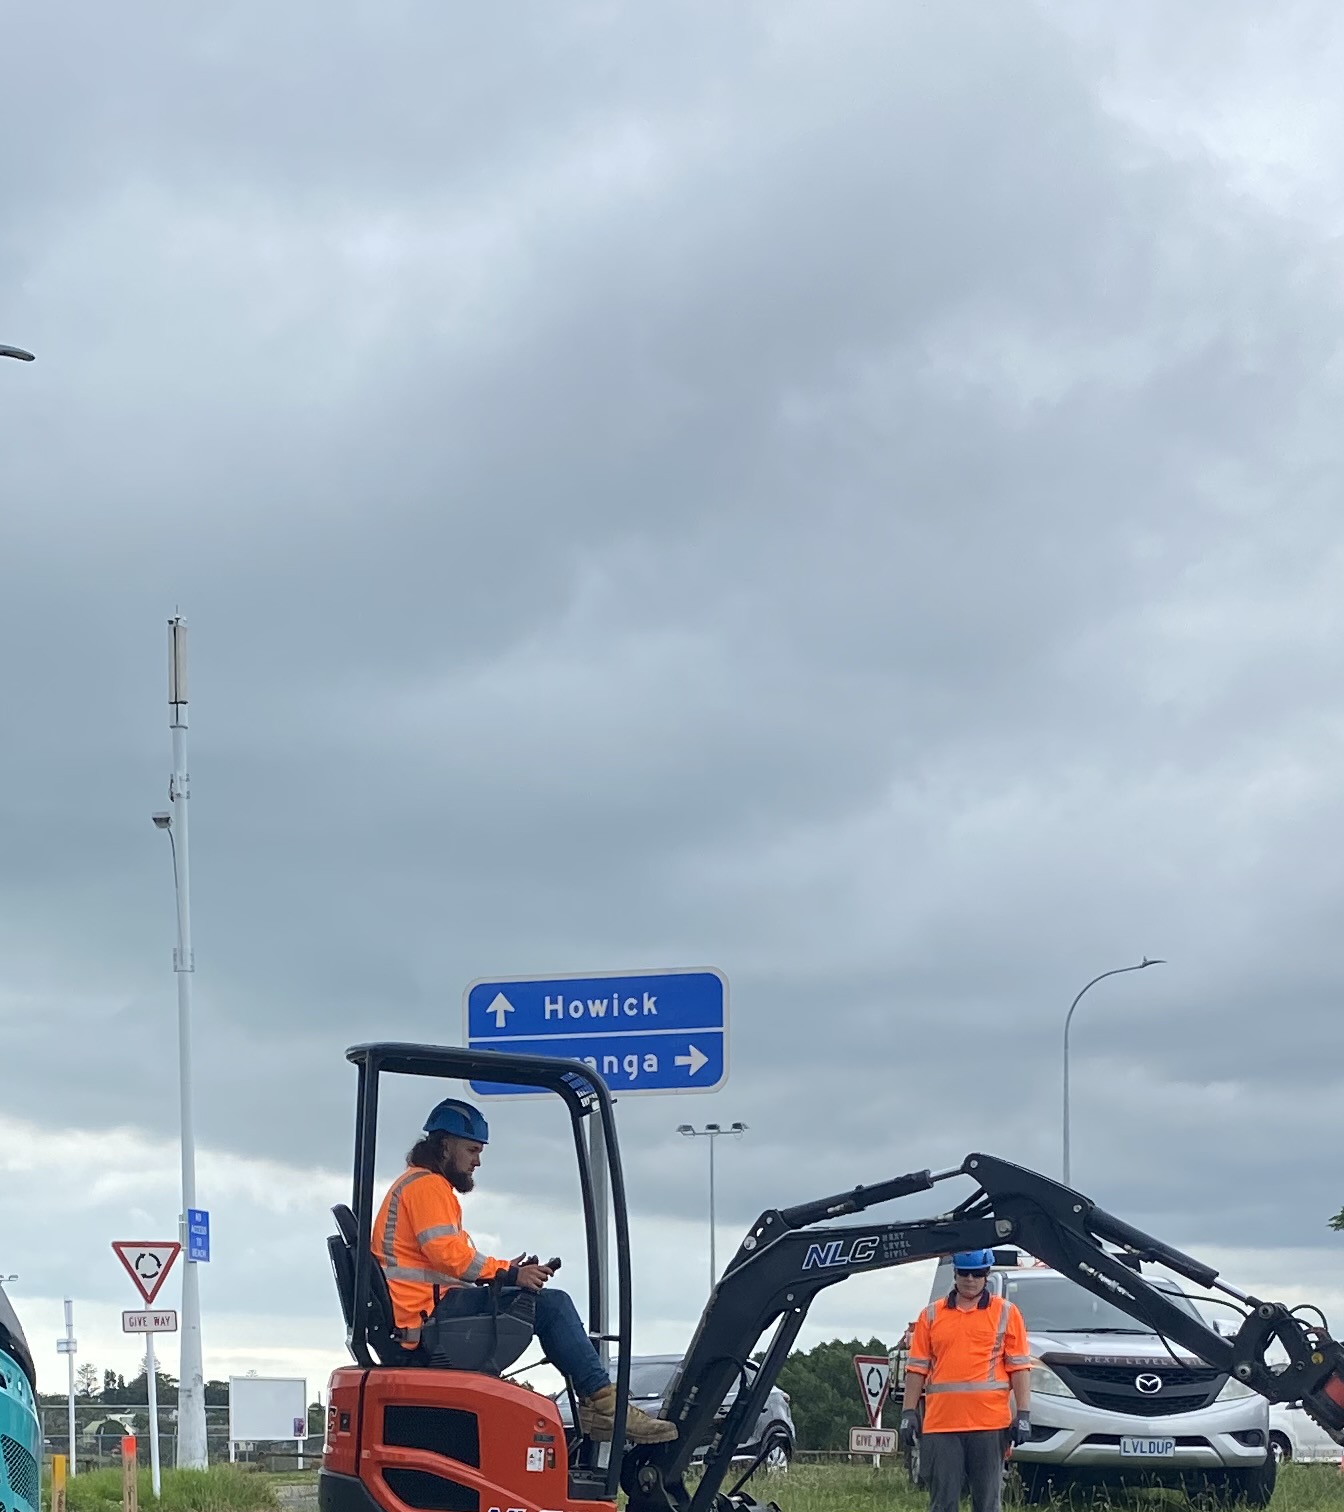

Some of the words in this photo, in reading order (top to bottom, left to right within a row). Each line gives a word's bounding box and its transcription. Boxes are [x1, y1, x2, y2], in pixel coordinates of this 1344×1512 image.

[544, 991, 658, 1021] Howick
[802, 1236, 880, 1270] NLC
[128, 1316, 147, 1327] GIVE
[154, 1315, 170, 1327] WAY
[1084, 1355, 1118, 1363] NEXT
[1126, 1357, 1168, 1365] LEVEL
[856, 1434, 872, 1447] GIVE
[875, 1435, 891, 1448] WAY
[1123, 1440, 1173, 1454] LVLDUP
